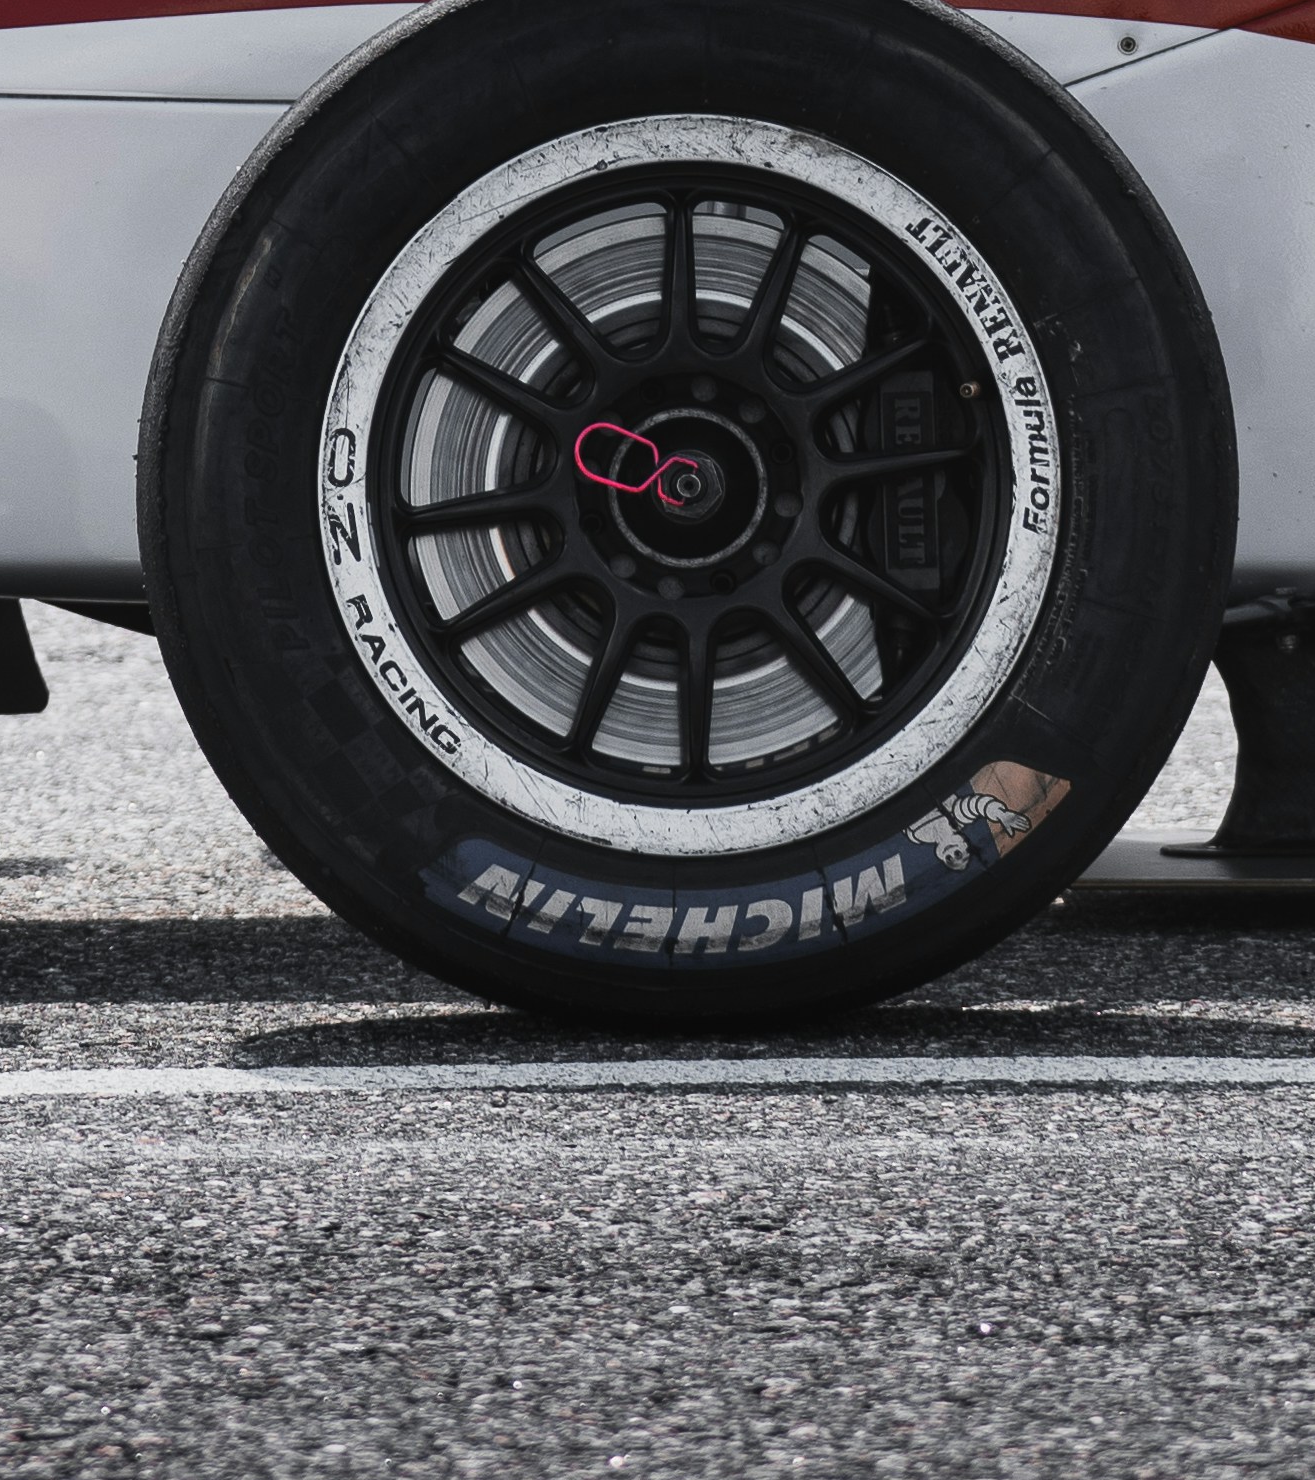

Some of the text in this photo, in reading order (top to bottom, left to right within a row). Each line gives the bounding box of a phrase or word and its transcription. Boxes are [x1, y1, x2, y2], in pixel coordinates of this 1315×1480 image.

[905, 217, 1051, 534] Formula RENAULT
[894, 397, 926, 564] REAULT
[346, 594, 461, 755] RACING
[457, 853, 906, 954] MICHELIN
